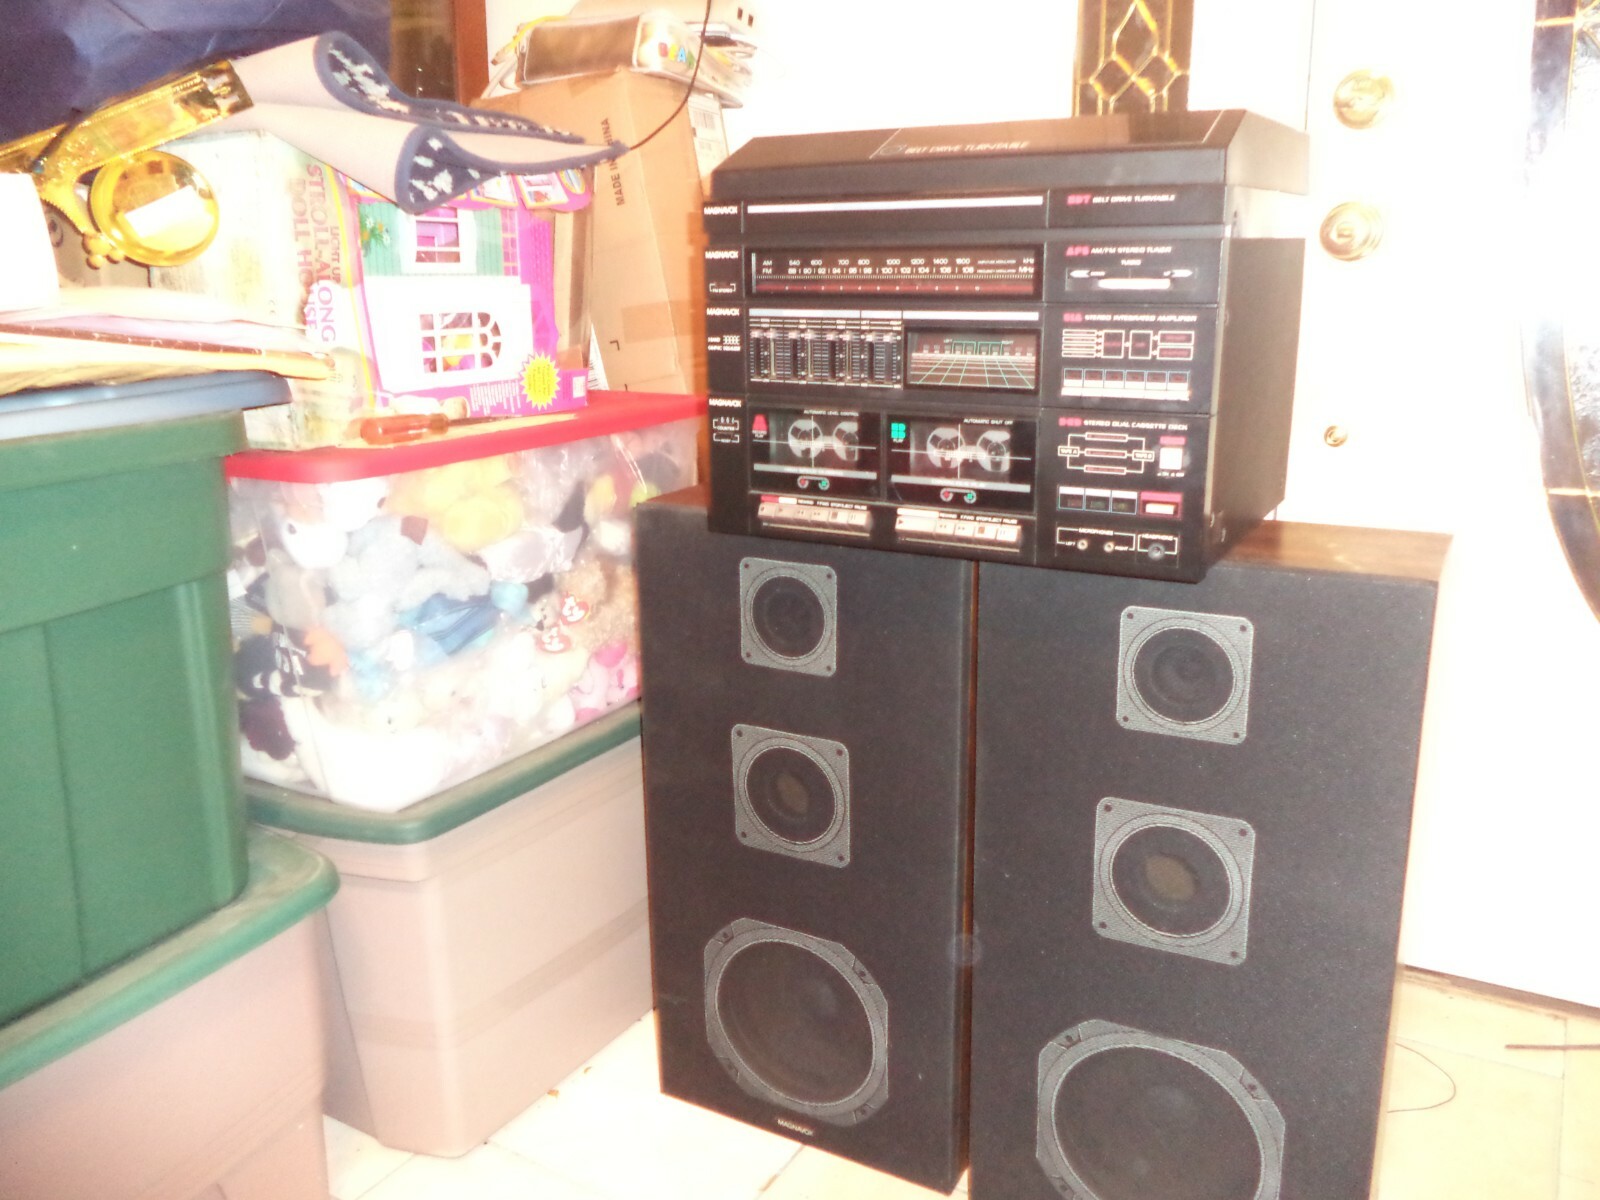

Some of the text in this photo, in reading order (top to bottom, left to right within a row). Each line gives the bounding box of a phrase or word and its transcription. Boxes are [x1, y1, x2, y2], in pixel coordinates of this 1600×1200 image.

[601, 118, 614, 147] HINA
[611, 173, 625, 206] MADE
[289, 178, 310, 242] DOLL
[703, 205, 738, 215] MAGNAVOX
[705, 250, 739, 259] MAGNAVOX
[1117, 246, 1145, 254] STEREO
[706, 307, 740, 316] MAGNAVOX
[708, 398, 742, 408] MAGNAVOX
[1083, 419, 1111, 427] STEREO
[777, 1119, 814, 1137] MAGNAVOX
